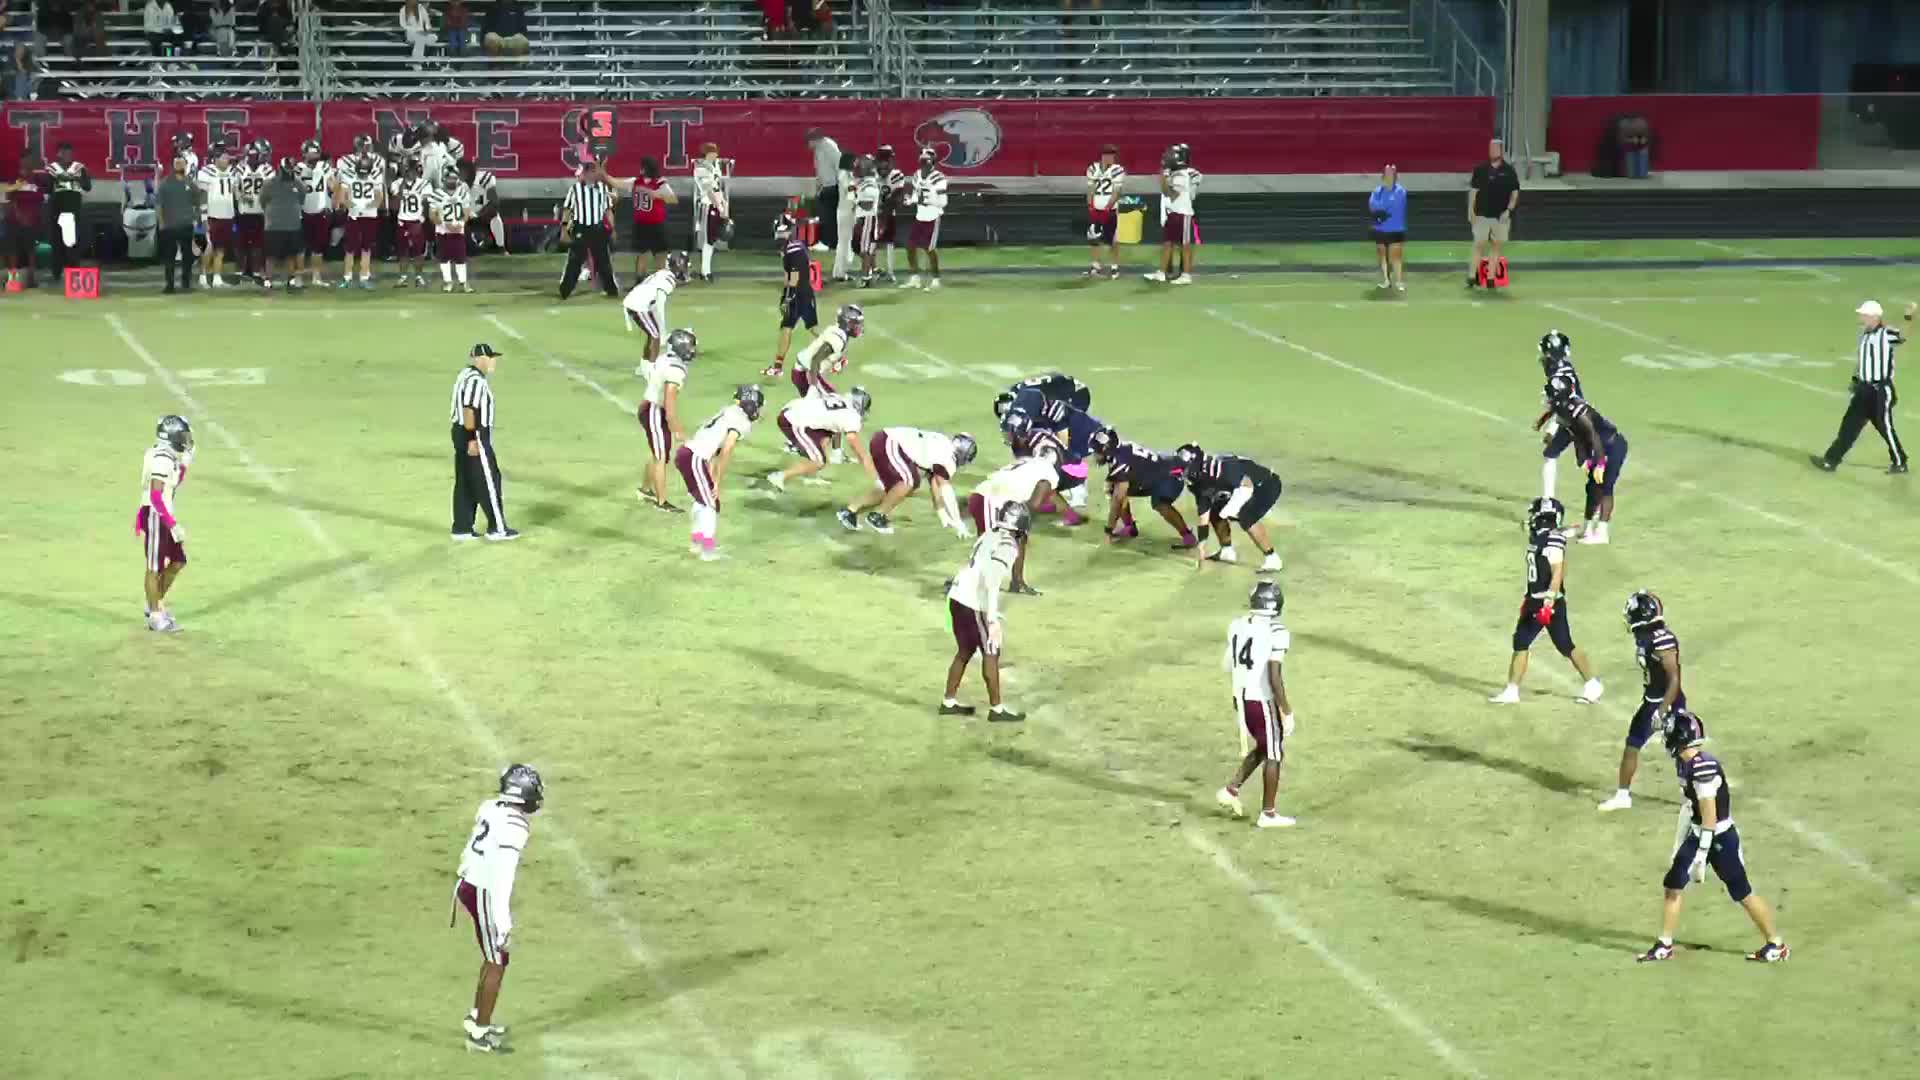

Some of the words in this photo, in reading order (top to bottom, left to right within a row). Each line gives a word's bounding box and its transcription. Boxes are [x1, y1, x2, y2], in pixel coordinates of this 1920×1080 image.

[591, 111, 613, 138] 3
[1094, 178, 1113, 197] 22
[442, 202, 463, 222] 20
[70, 270, 96, 292] 50
[1232, 633, 1255, 671] 14
[471, 818, 490, 856] 2
